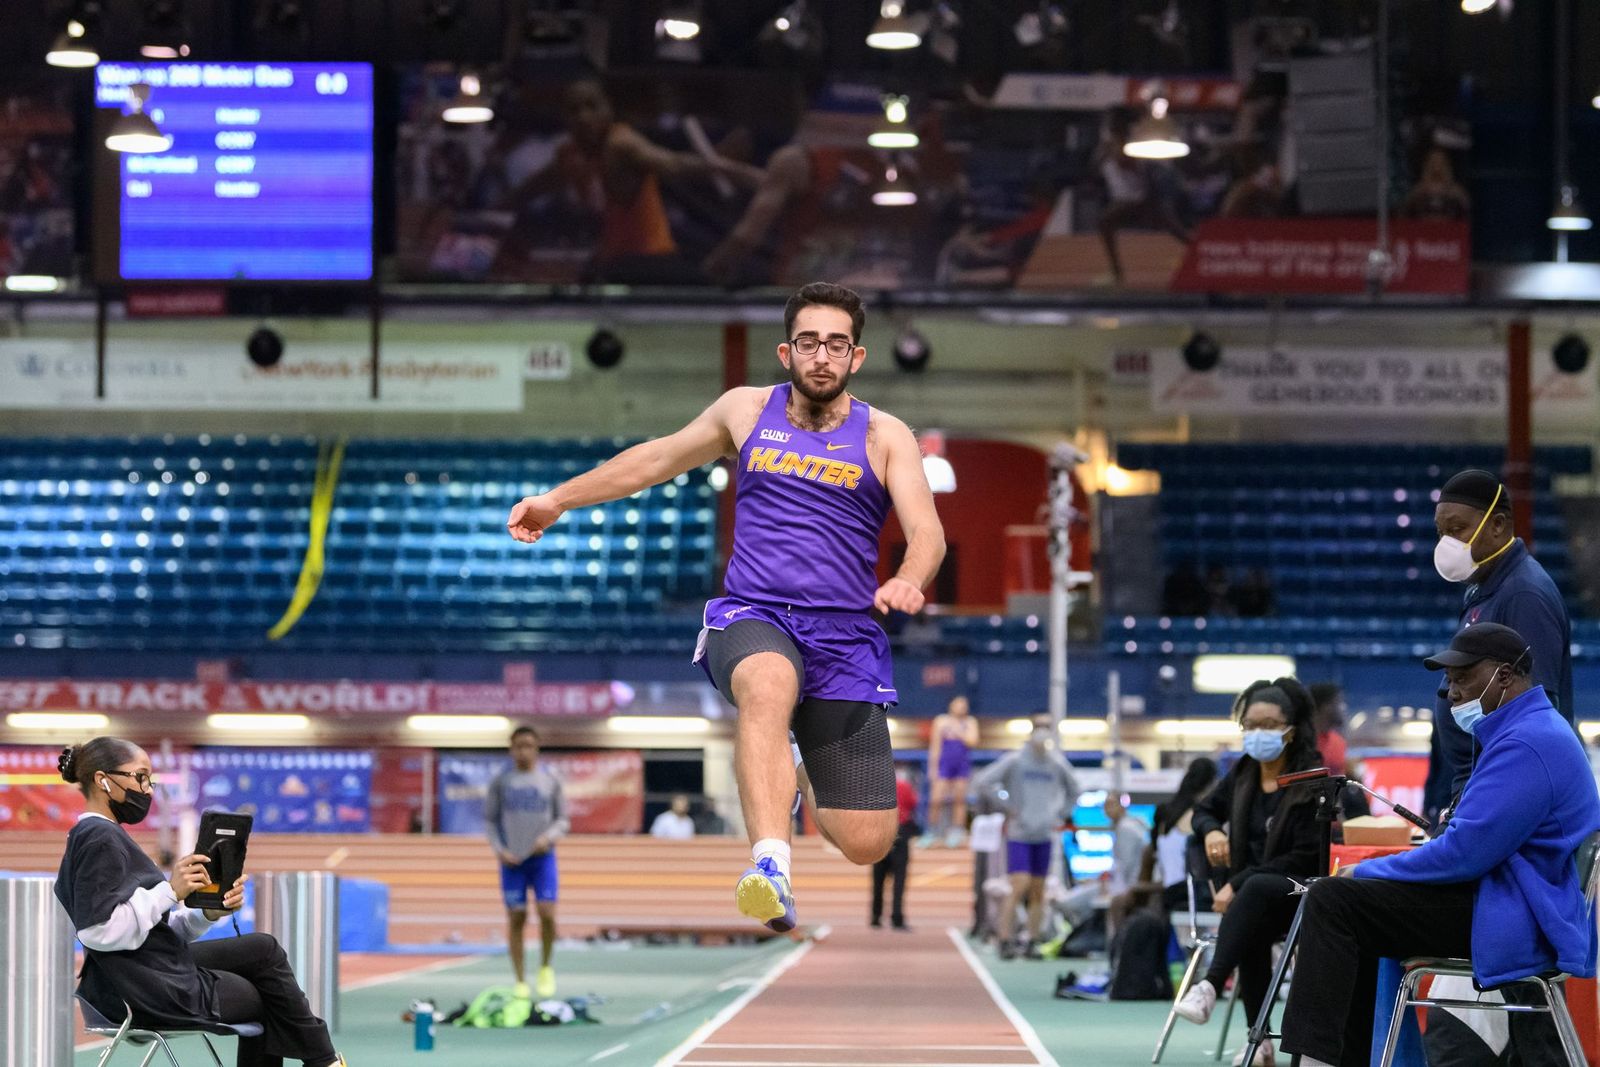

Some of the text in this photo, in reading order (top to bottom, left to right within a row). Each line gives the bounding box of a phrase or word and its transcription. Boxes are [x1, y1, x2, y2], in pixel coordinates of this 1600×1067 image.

[168, 65, 201, 87] 200
[202, 65, 254, 87] Meter
[1247, 239, 1333, 257] balance
[1314, 357, 1366, 379] YOU
[1378, 358, 1411, 379] TO
[1424, 360, 1462, 379] ALL
[1250, 384, 1499, 404] GENEROUS DONORS
[760, 428, 792, 443] CUNY
[747, 447, 863, 489] HUNTER
[72, 682, 209, 710] TRACK
